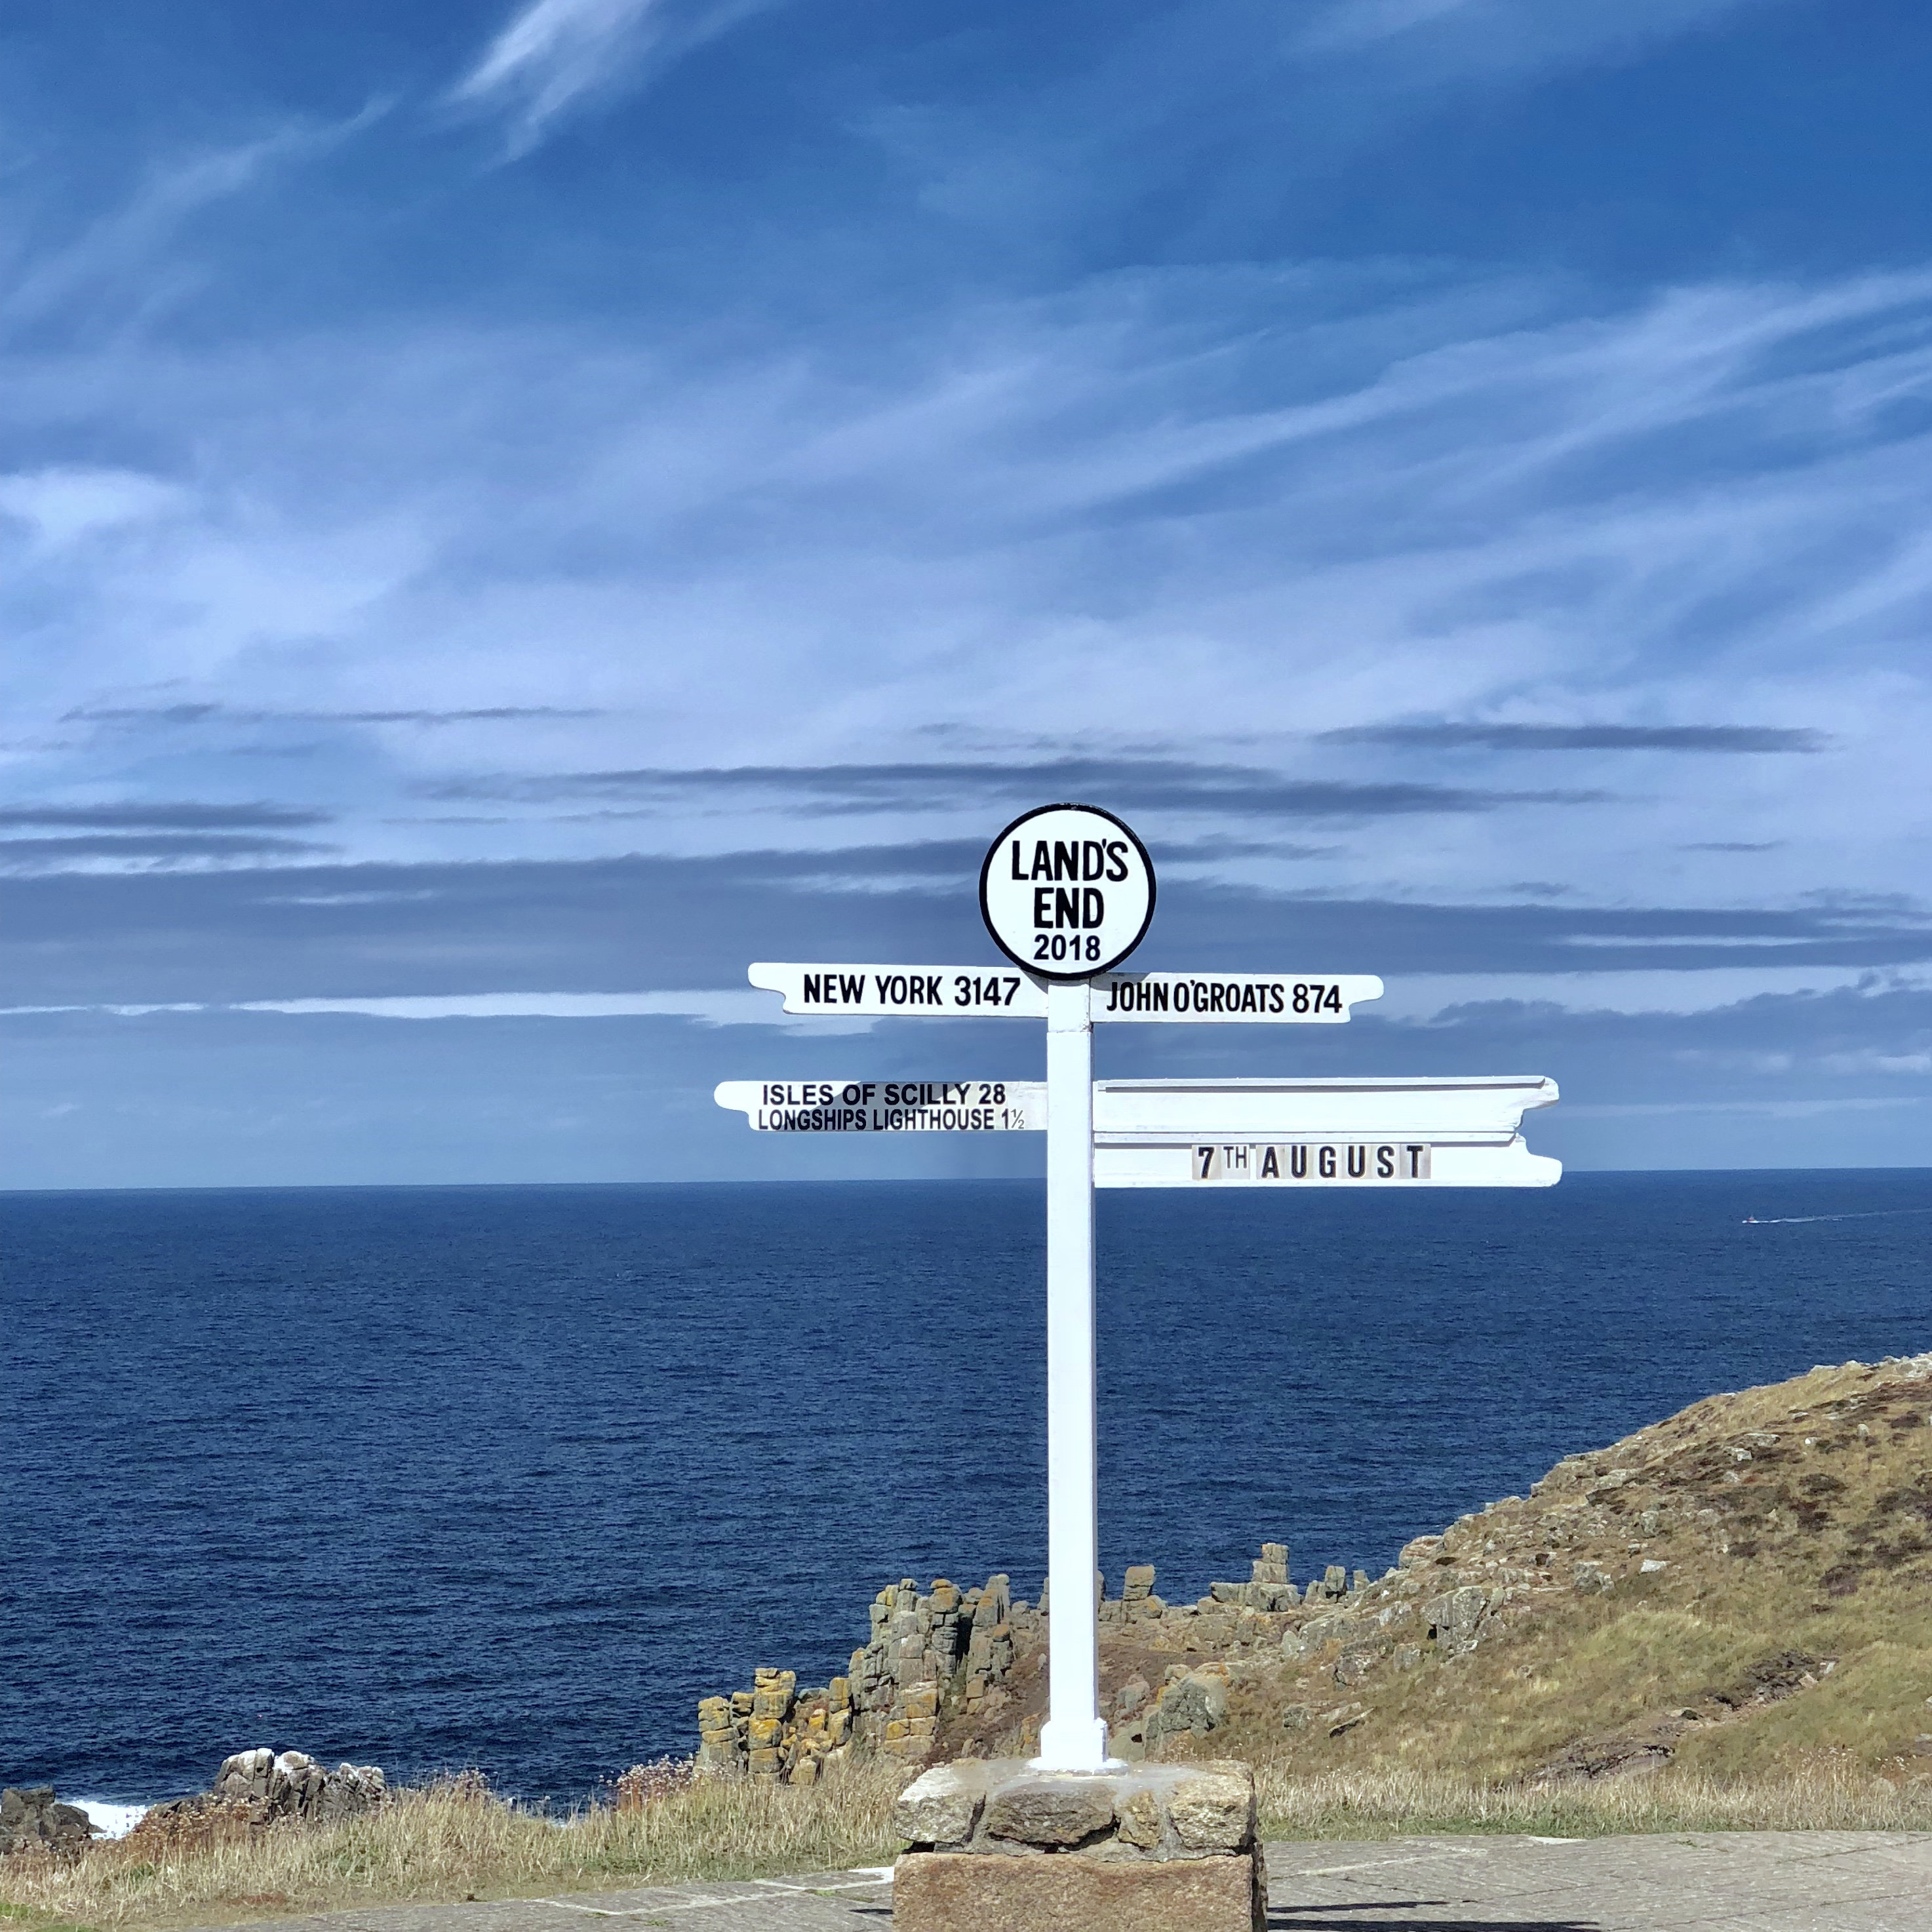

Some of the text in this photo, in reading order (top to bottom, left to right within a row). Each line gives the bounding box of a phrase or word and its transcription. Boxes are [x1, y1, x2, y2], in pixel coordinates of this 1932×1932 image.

[1012, 838, 1128, 882] LAND'S
[1034, 888, 1104, 928] END
[1033, 934, 1101, 961] 2018
[804, 974, 1021, 1006] NEW YORK 3147
[1107, 979, 1343, 1013] JOHN O'GROATS 874
[763, 1084, 1006, 1106] ISLES OF SCILLY 28
[759, 1109, 867, 1131] LONGSHIPS
[873, 1109, 994, 1130] LIGHTHOUSE
[1261, 1145, 1425, 1179] AUGUST
